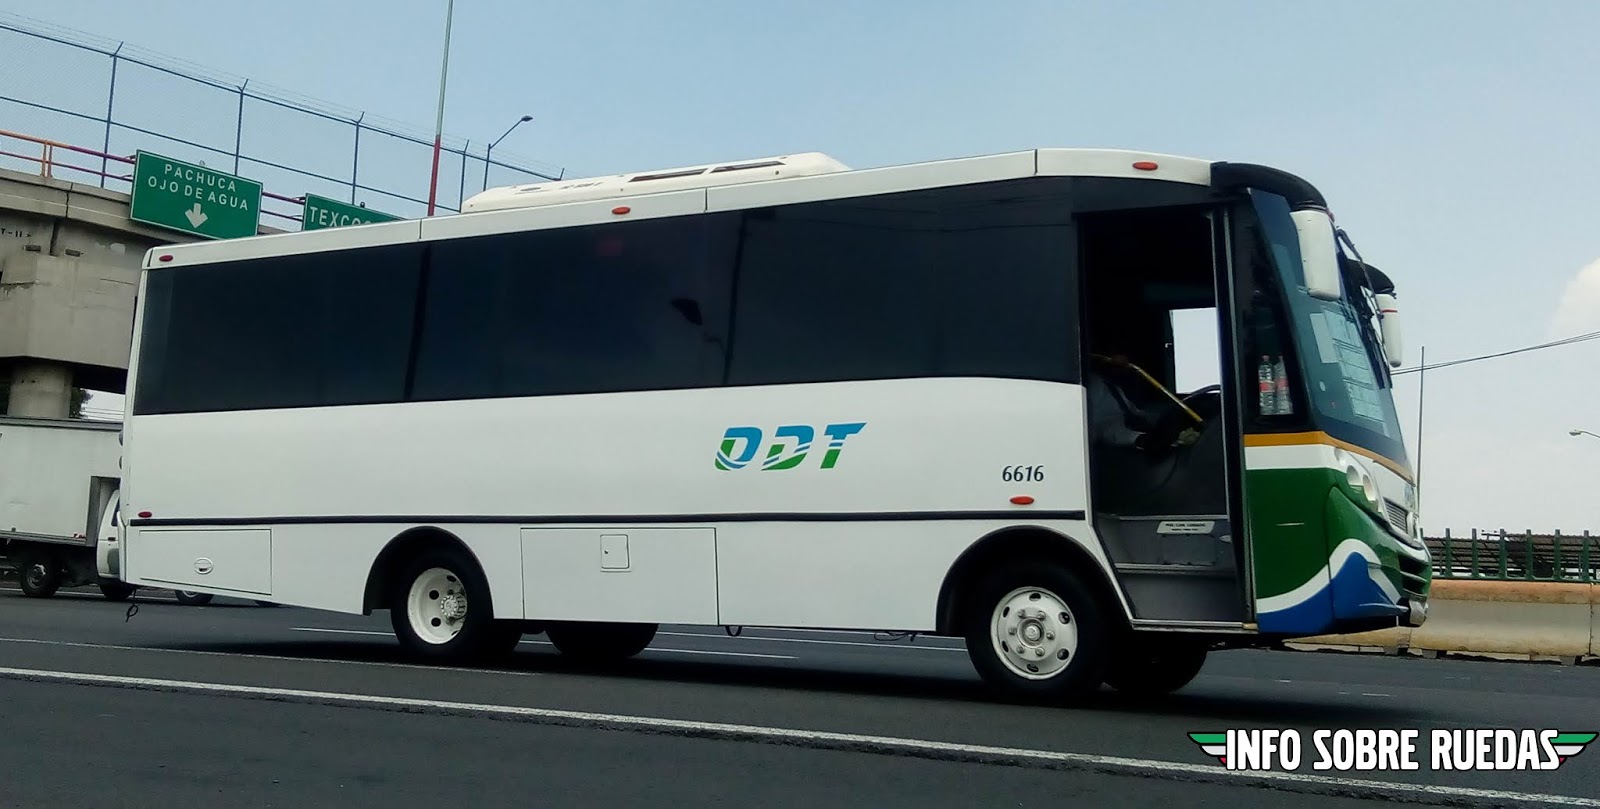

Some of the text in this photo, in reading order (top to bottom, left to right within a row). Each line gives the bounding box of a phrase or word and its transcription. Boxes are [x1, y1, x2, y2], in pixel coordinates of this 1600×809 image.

[164, 163, 236, 192] PACHUCA
[147, 175, 248, 211] OJO DE AGUA
[310, 206, 372, 228] TEXC
[715, 422, 867, 471] ODT
[1002, 465, 1044, 482] 6616
